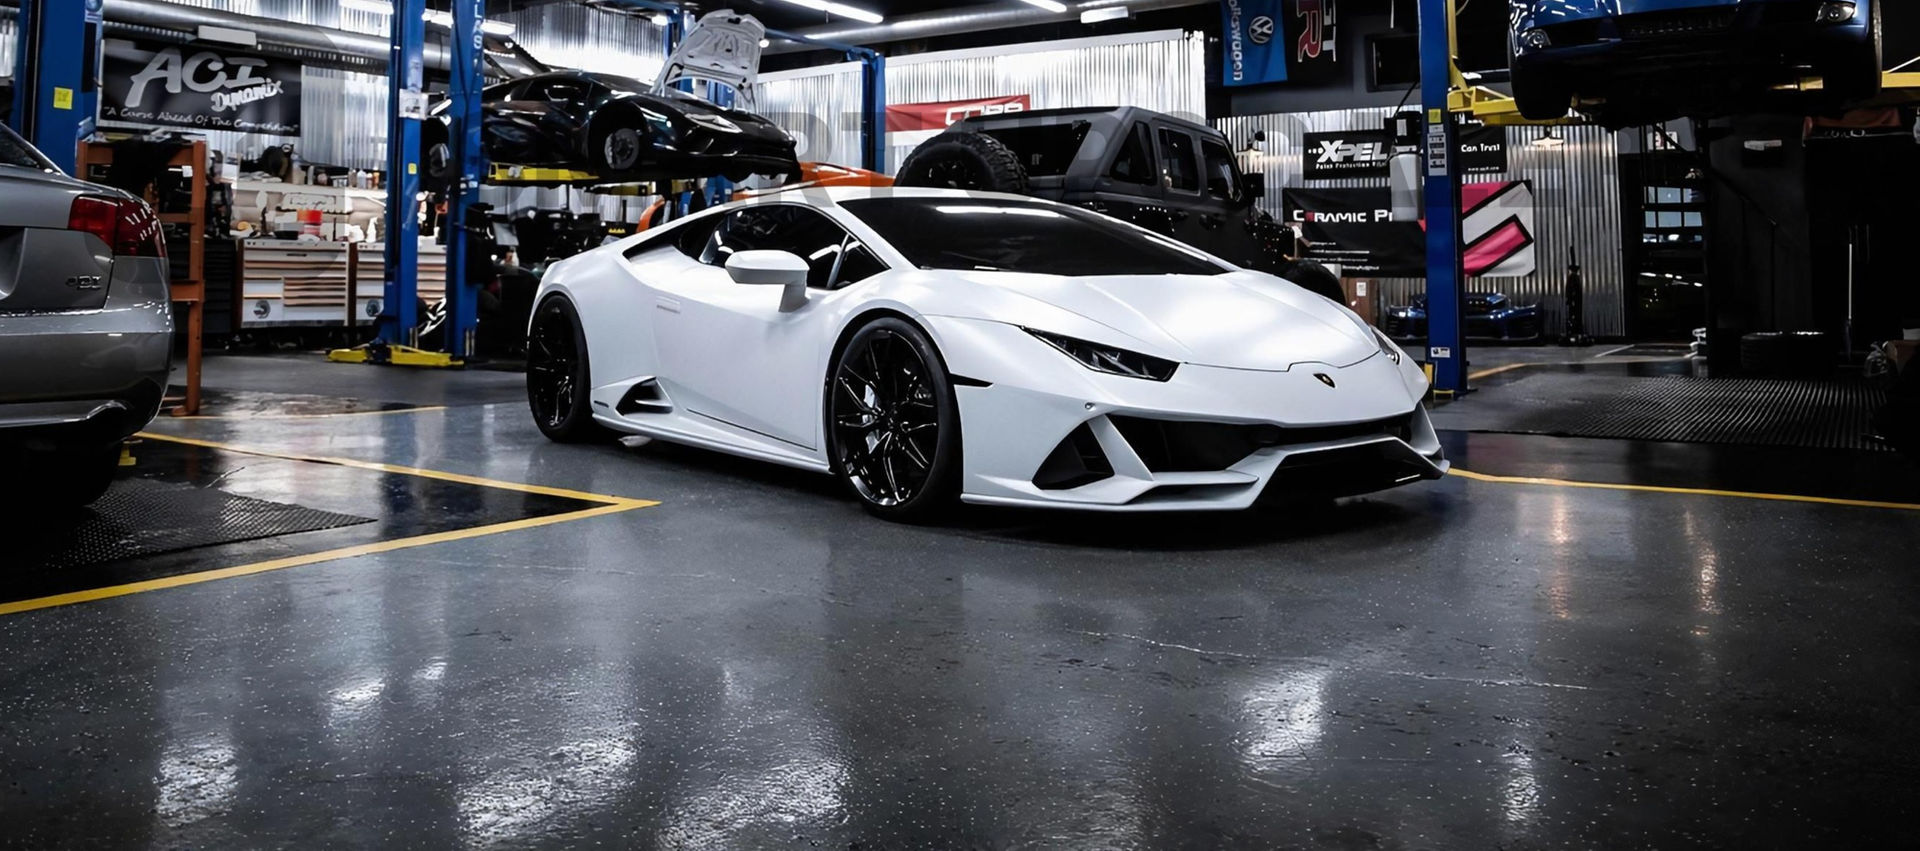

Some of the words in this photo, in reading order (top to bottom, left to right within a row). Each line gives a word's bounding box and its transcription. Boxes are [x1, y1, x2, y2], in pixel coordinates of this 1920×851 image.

[1228, 0, 1243, 81] olkswagen
[124, 48, 268, 107] ACI
[1461, 144, 1478, 152] Can
